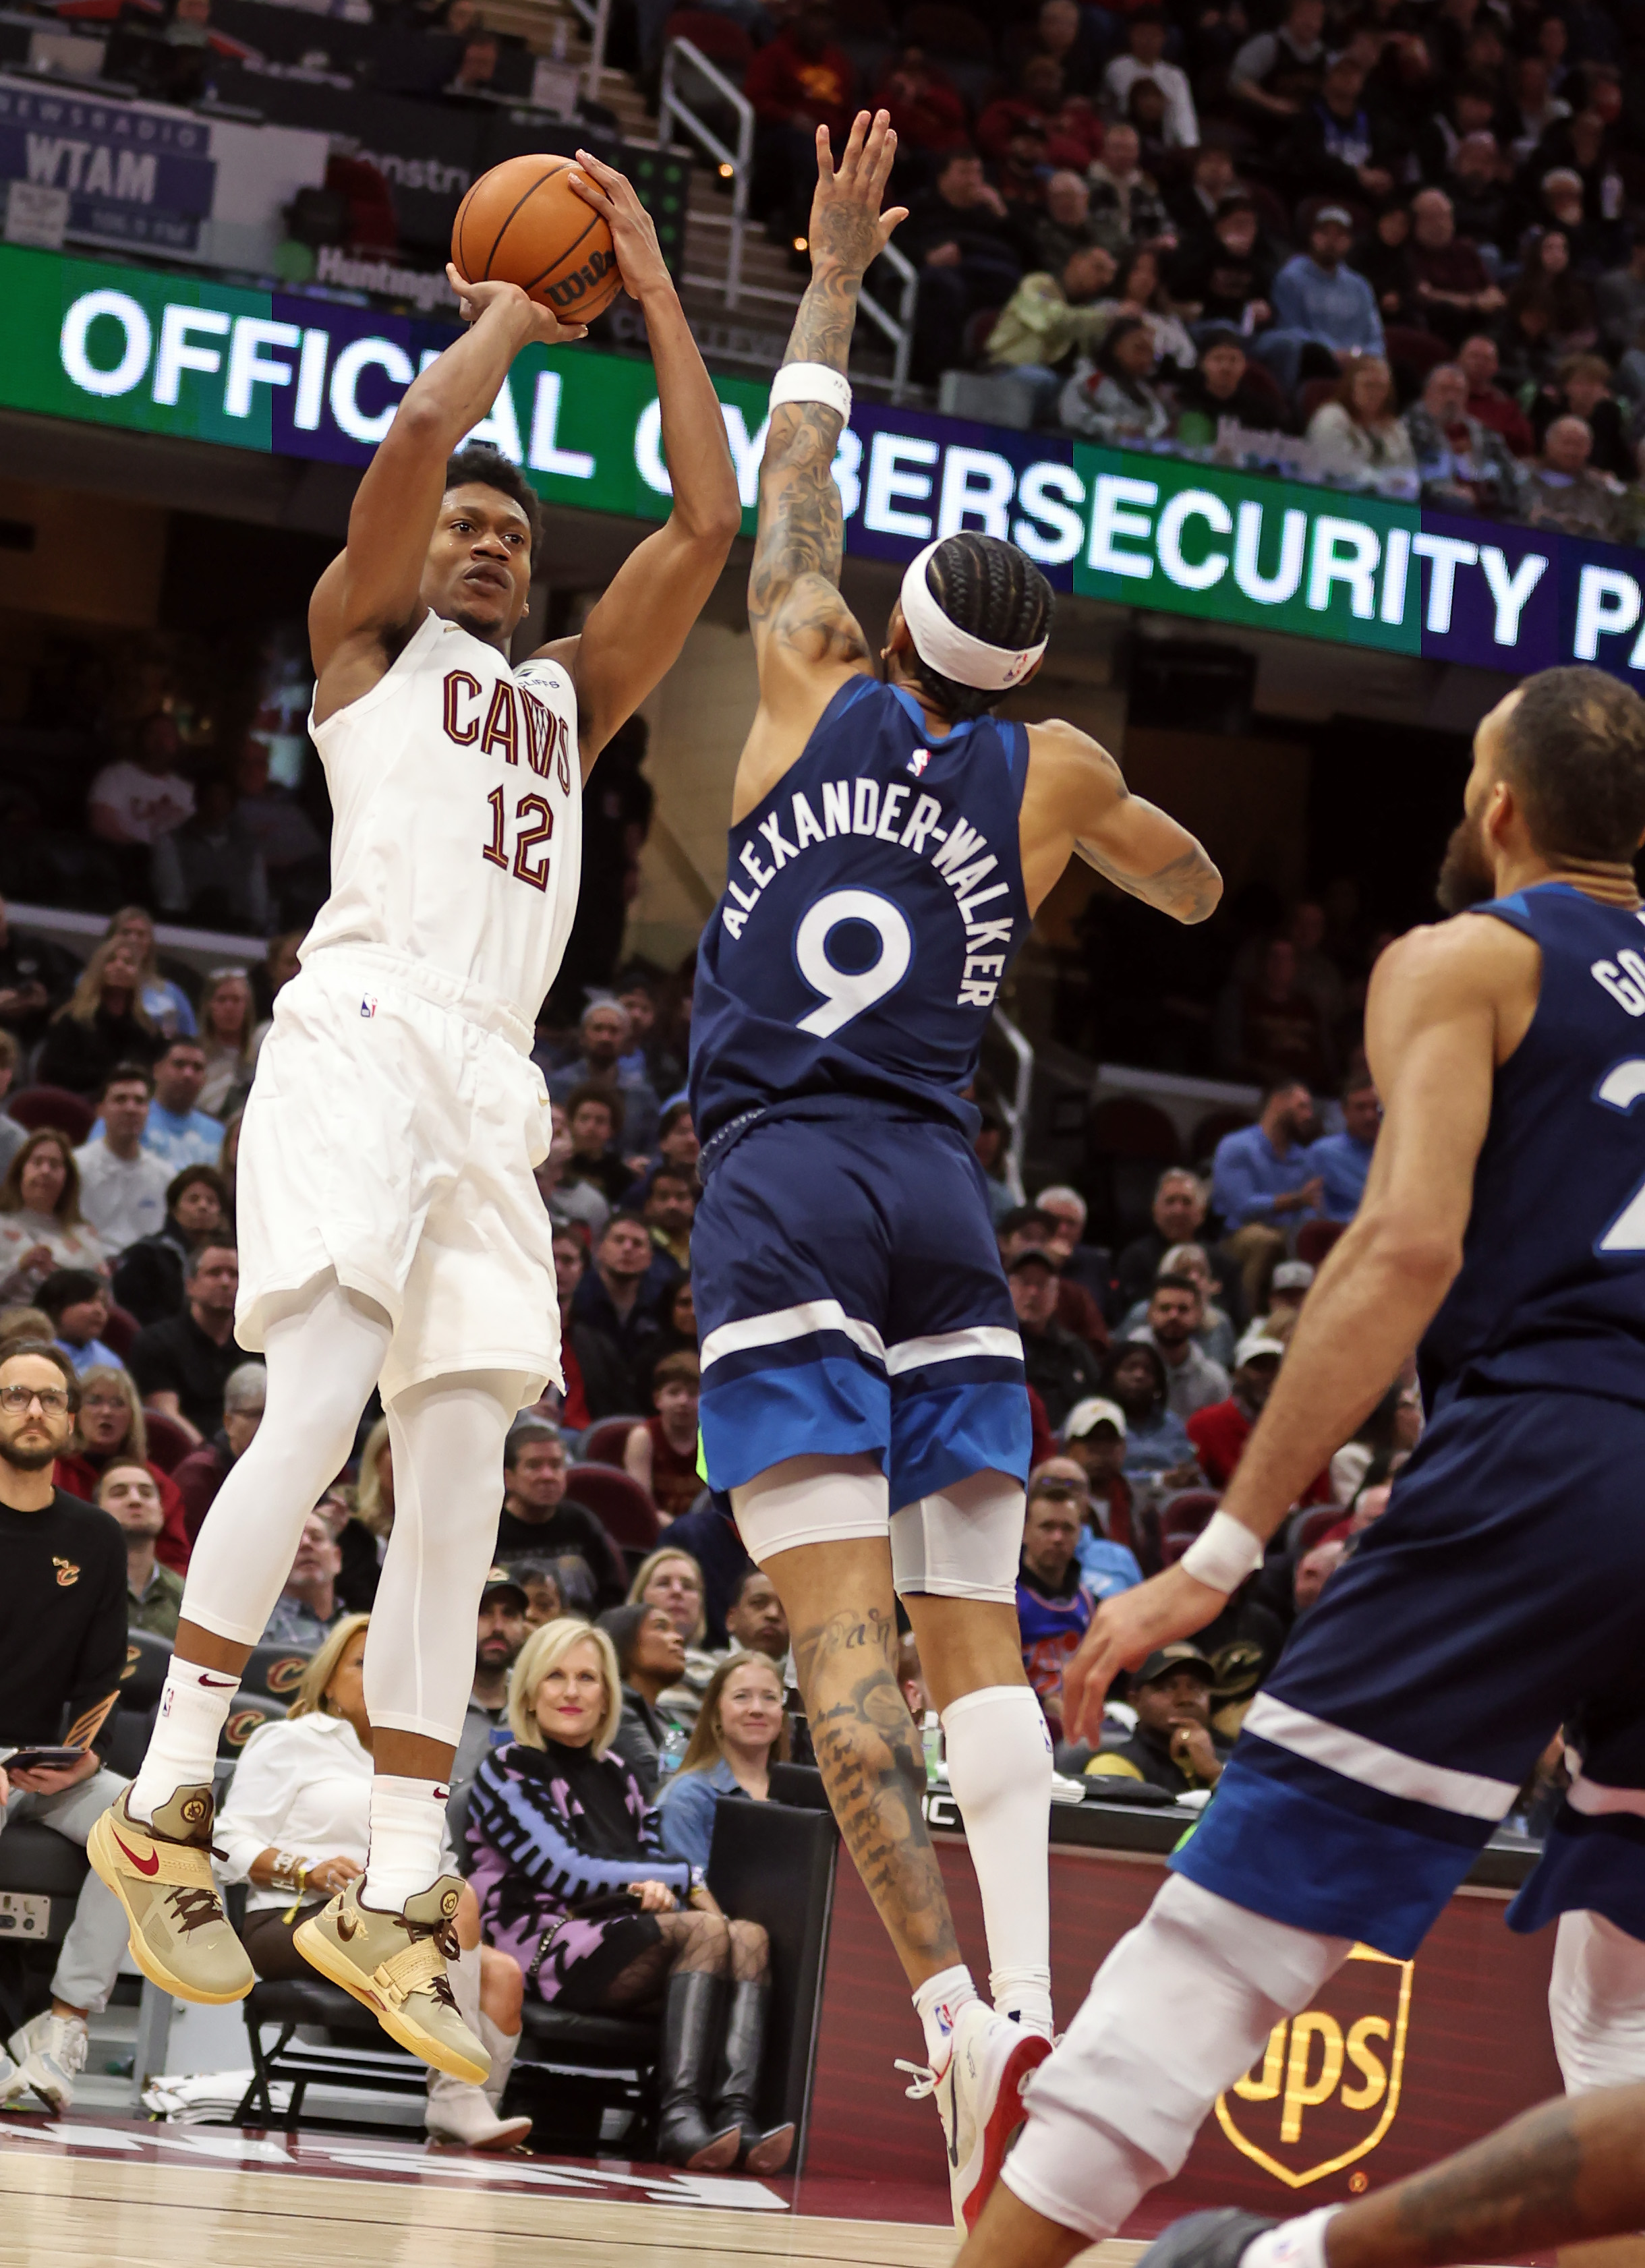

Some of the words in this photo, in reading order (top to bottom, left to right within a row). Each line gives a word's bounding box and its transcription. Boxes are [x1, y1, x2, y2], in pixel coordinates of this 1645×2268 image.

[26, 132, 158, 204] WTAM
[316, 243, 461, 312] Huntingt
[60, 288, 596, 479] OFFICAL
[1573, 564, 1645, 670] P
[443, 669, 570, 798] CAVS
[482, 783, 554, 893] 12
[722, 777, 1014, 1008] ALEXANDER-WALKER
[795, 888, 913, 1039] 9
[1232, 2010, 1391, 2143] ups
